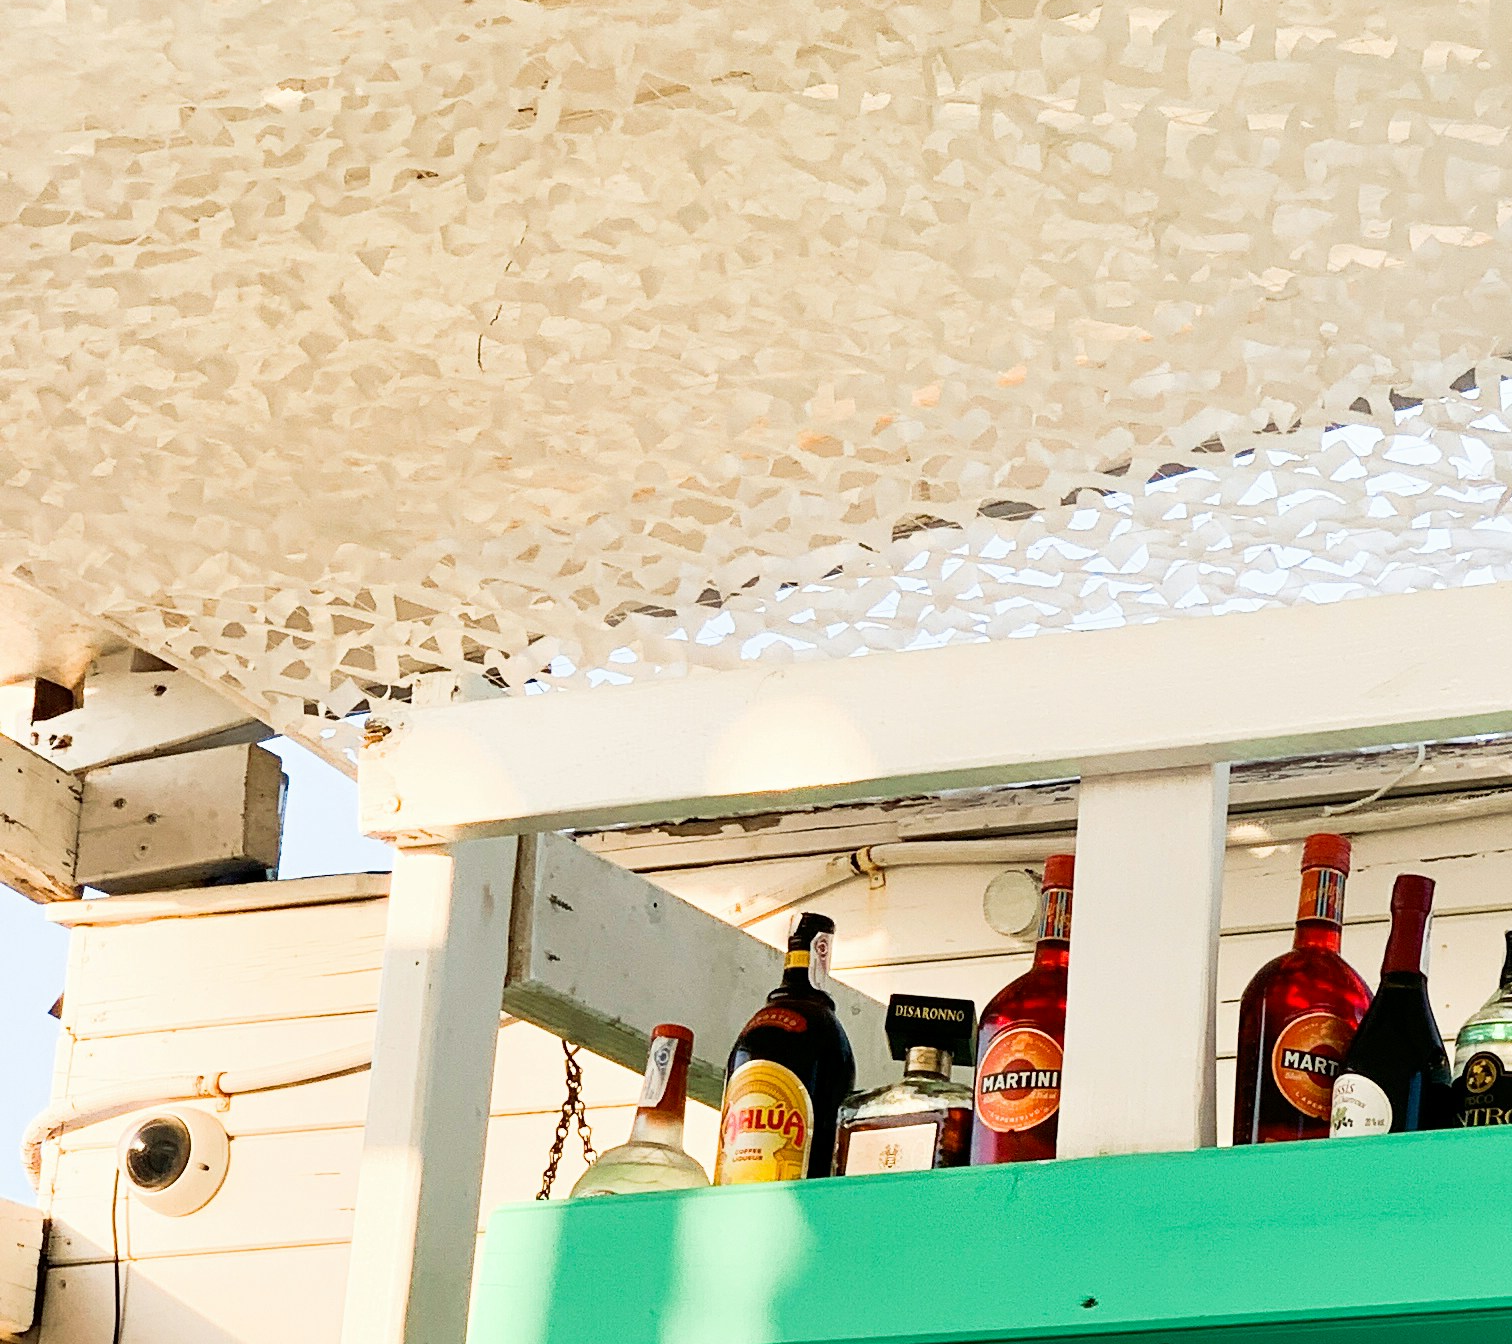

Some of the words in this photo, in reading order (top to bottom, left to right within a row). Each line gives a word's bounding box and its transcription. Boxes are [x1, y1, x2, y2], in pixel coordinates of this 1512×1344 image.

[894, 1004, 965, 1023] DISARONNO
[1283, 1050, 1340, 1077] MART
[982, 1071, 1059, 1093] MARTINI
[723, 1103, 806, 1149] AHLÚA
